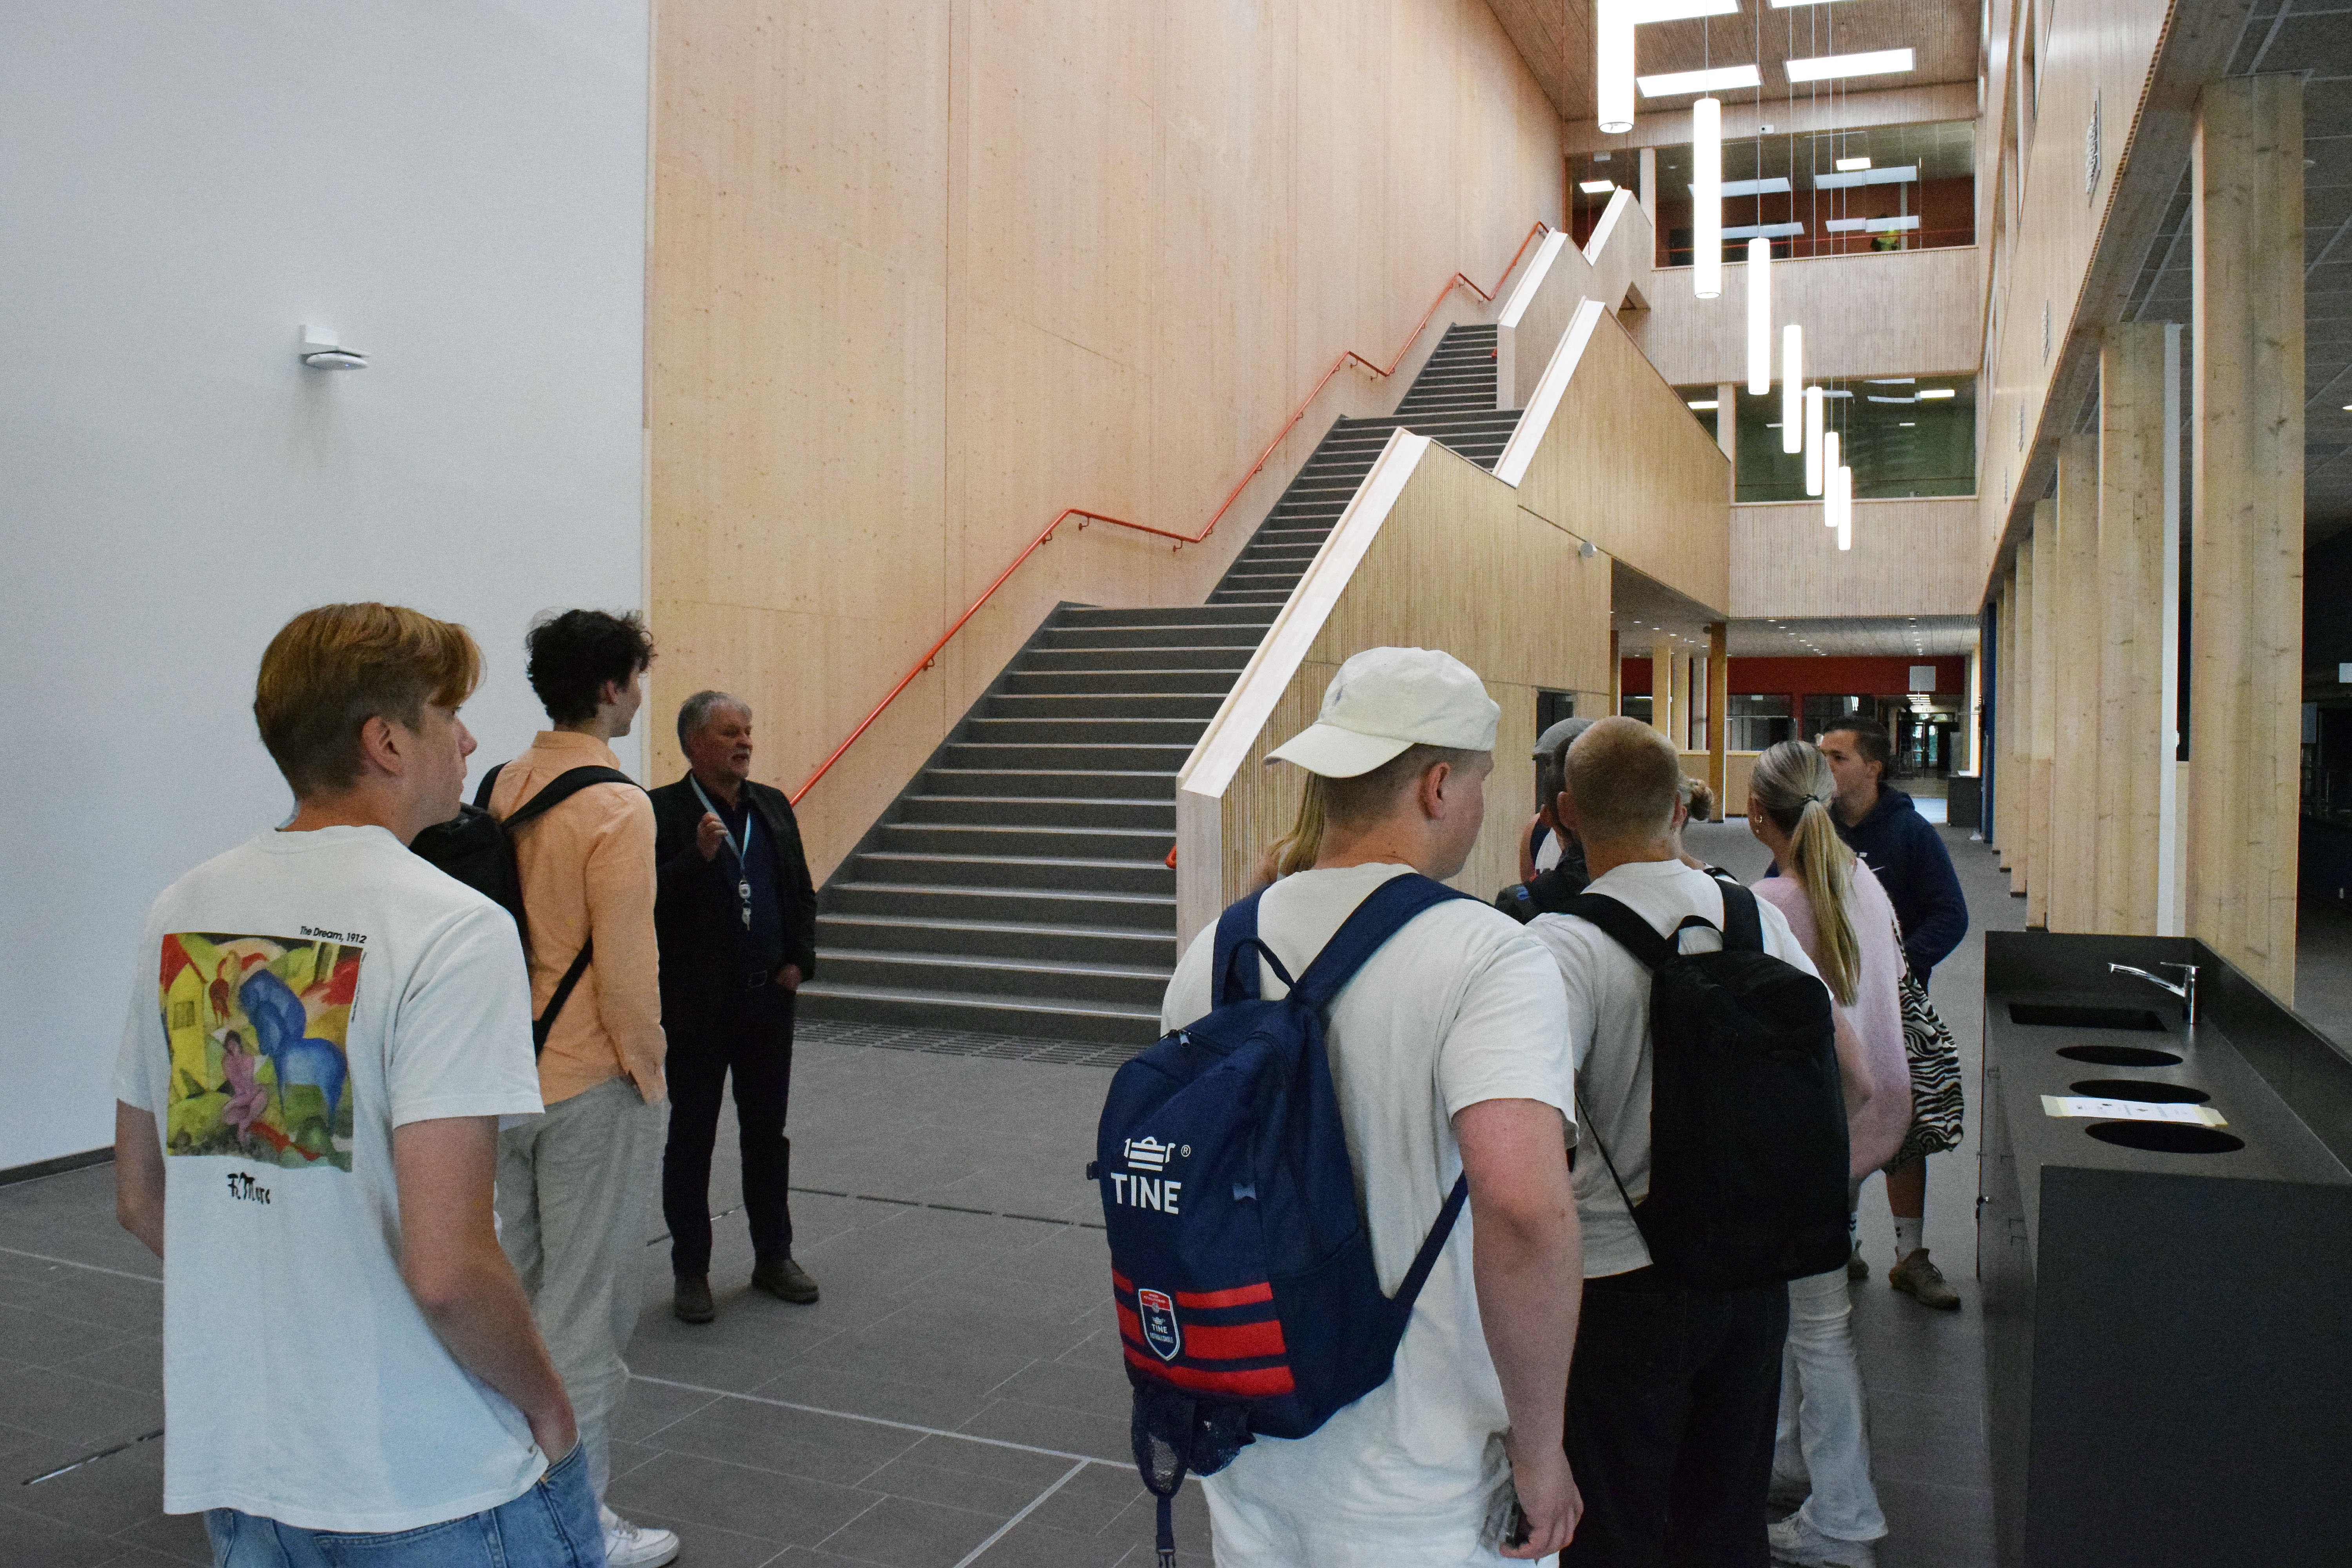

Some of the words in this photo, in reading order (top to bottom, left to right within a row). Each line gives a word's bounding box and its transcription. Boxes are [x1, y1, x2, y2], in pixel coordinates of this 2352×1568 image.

[300, 926, 312, 936] The
[313, 927, 343, 942] Dream,
[347, 933, 367, 944] 1912
[1111, 1172, 1181, 1214] TINE
[1151, 1323, 1168, 1334] TINE
